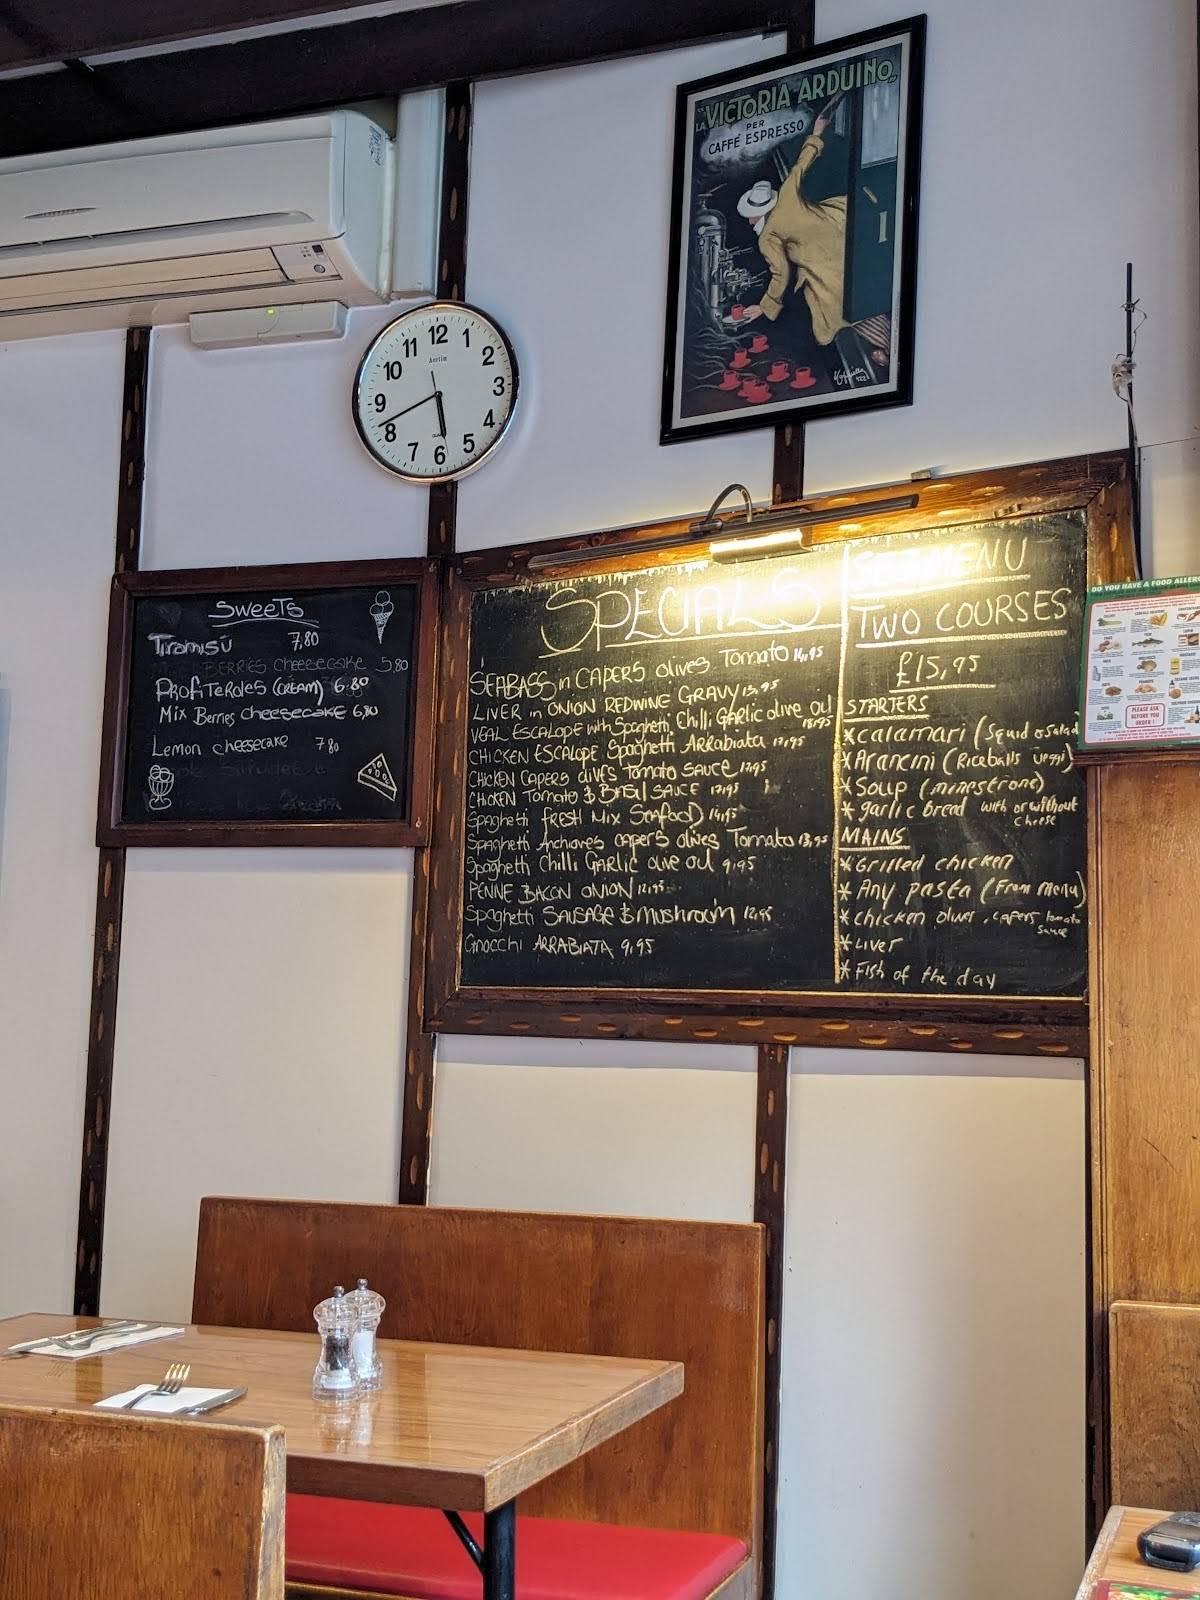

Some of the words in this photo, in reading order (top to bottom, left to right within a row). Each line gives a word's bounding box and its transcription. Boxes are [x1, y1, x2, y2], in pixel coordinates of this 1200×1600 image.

[745, 119, 804, 145] ESPRESSO
[746, 120, 764, 131] PER
[428, 324, 448, 345] 12
[462, 328, 470, 347] 1
[402, 338, 417, 358] 11
[482, 346, 494, 366] 2
[383, 361, 402, 381] 10
[493, 377, 505, 396] 3
[374, 393, 386, 412] 9
[483, 409, 495, 428] 4
[384, 423, 396, 442] 8
[463, 433, 475, 453] 5
[408, 442, 418, 461] 7
[434, 445, 445, 465] 6
[1122, 582, 1142, 590] HAVE
[1151, 578, 1172, 587] FOOD
[540, 568, 823, 652] SPECIALS
[851, 604, 920, 640] TWO
[936, 588, 1072, 631] COURSES
[470, 670, 557, 701] SEABASS
[559, 676, 570, 690] in
[576, 661, 645, 692] CAPERS
[719, 640, 789, 667] Tomato
[473, 704, 522, 721] LIVER
[530, 710, 542, 719] in
[547, 699, 596, 717] ONION
[605, 693, 671, 714] REDWINE
[678, 684, 740, 715] GRAVY
[845, 695, 929, 715] STARTERS
[160, 705, 187, 723] Mix
[193, 706, 236, 727] Berries
[471, 726, 509, 744] VEAL
[512, 723, 583, 743] ESCALOPE
[587, 718, 611, 735] with
[676, 708, 712, 730] Chilli
[767, 698, 802, 720] olive
[857, 722, 966, 744] calamari
[152, 735, 201, 756] Lemon
[212, 735, 289, 755] cheesecake
[469, 749, 529, 765] CHICKEN
[534, 744, 599, 769] ESCALOPE
[607, 734, 675, 767] Spaghetti
[854, 749, 935, 773] Arancini
[469, 770, 515, 788] CHICKEN
[622, 761, 677, 780] Tomato
[681, 759, 739, 778] SAUCE
[469, 791, 516, 809] CHICKEN
[522, 786, 579, 805] Tomato
[650, 782, 700, 800] SAUCE
[857, 776, 908, 800] Soup
[467, 808, 529, 834] Spaghetti
[591, 803, 621, 825] Mix
[858, 799, 915, 822] garlic
[922, 796, 967, 817] bread
[467, 830, 530, 857] Spaghetti
[676, 829, 720, 850] olives
[726, 826, 795, 848] Tomato
[841, 827, 907, 846] MAINS
[467, 854, 530, 881] Spaghetti
[539, 851, 578, 872] Chilli
[856, 854, 925, 874] Grilled
[935, 853, 1014, 871] chicken
[470, 880, 513, 903] PENNE
[518, 882, 571, 904] BACON
[581, 876, 633, 899] ONION
[856, 878, 896, 910] Any
[905, 878, 972, 905] pasta
[464, 905, 534, 932] Spaghetti
[542, 904, 615, 926] SAUSAGE
[854, 907, 926, 928] chicken
[464, 933, 522, 954] Gnocchi
[533, 934, 615, 959] ARRABIATA
[856, 937, 904, 953] Liver
[856, 959, 884, 980] Fish
[893, 964, 911, 984] of
[921, 966, 948, 985] the
[957, 967, 996, 990] day
